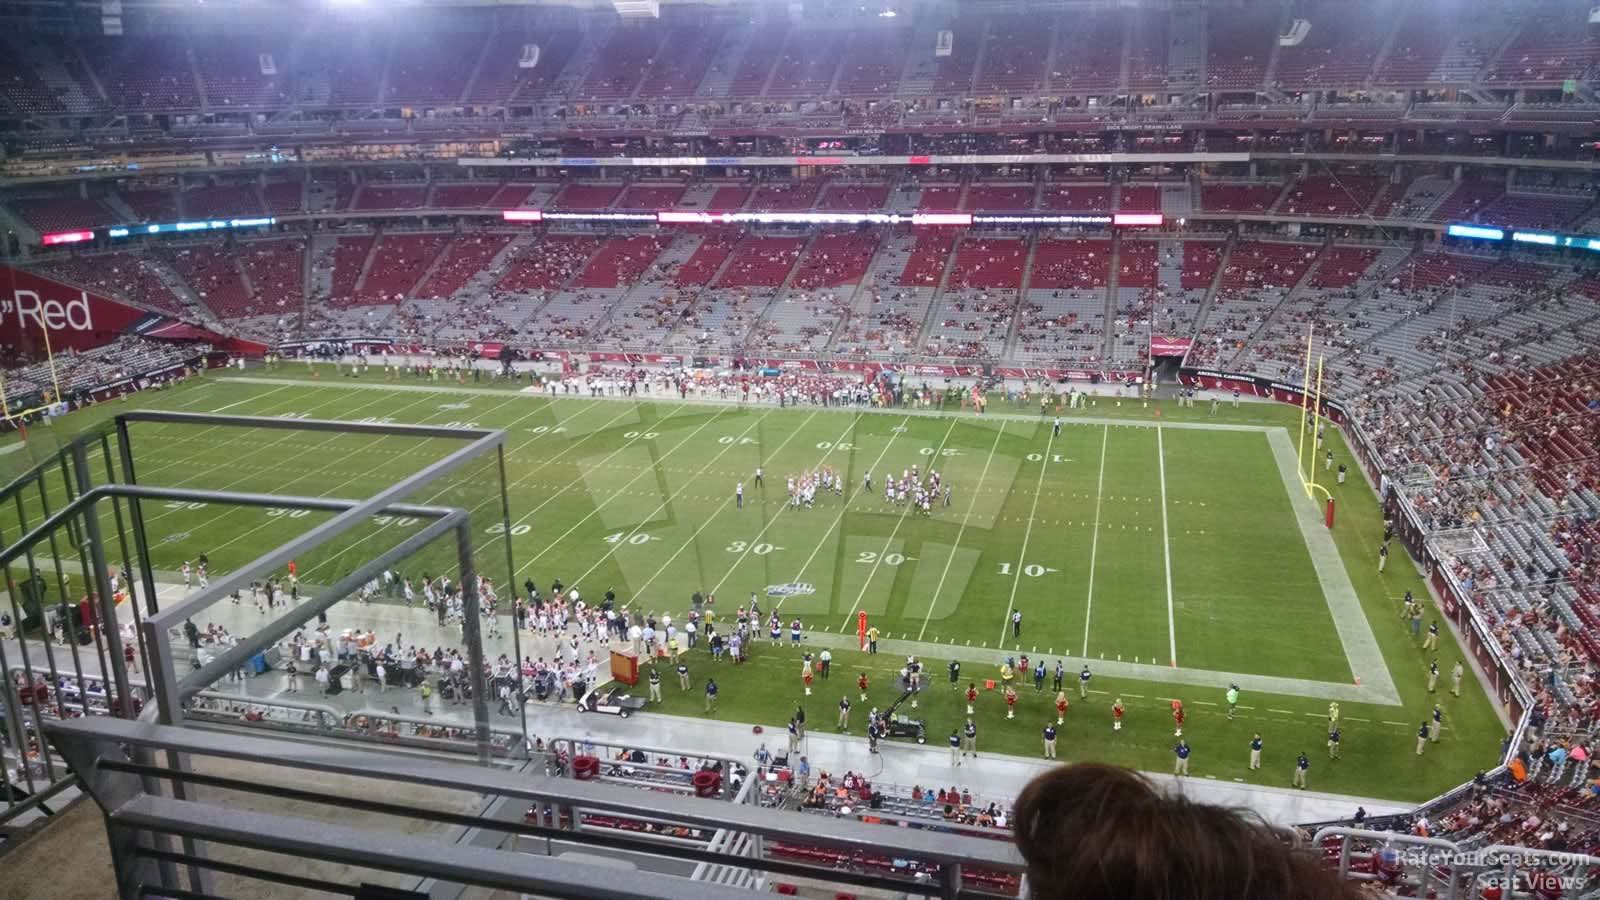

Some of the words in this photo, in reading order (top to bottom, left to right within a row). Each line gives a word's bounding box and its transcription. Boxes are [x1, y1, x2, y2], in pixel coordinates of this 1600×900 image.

[603, 532, 650, 545] 40
[725, 541, 774, 555] 30
[855, 551, 905, 566] 20
[996, 562, 1045, 577] 10
